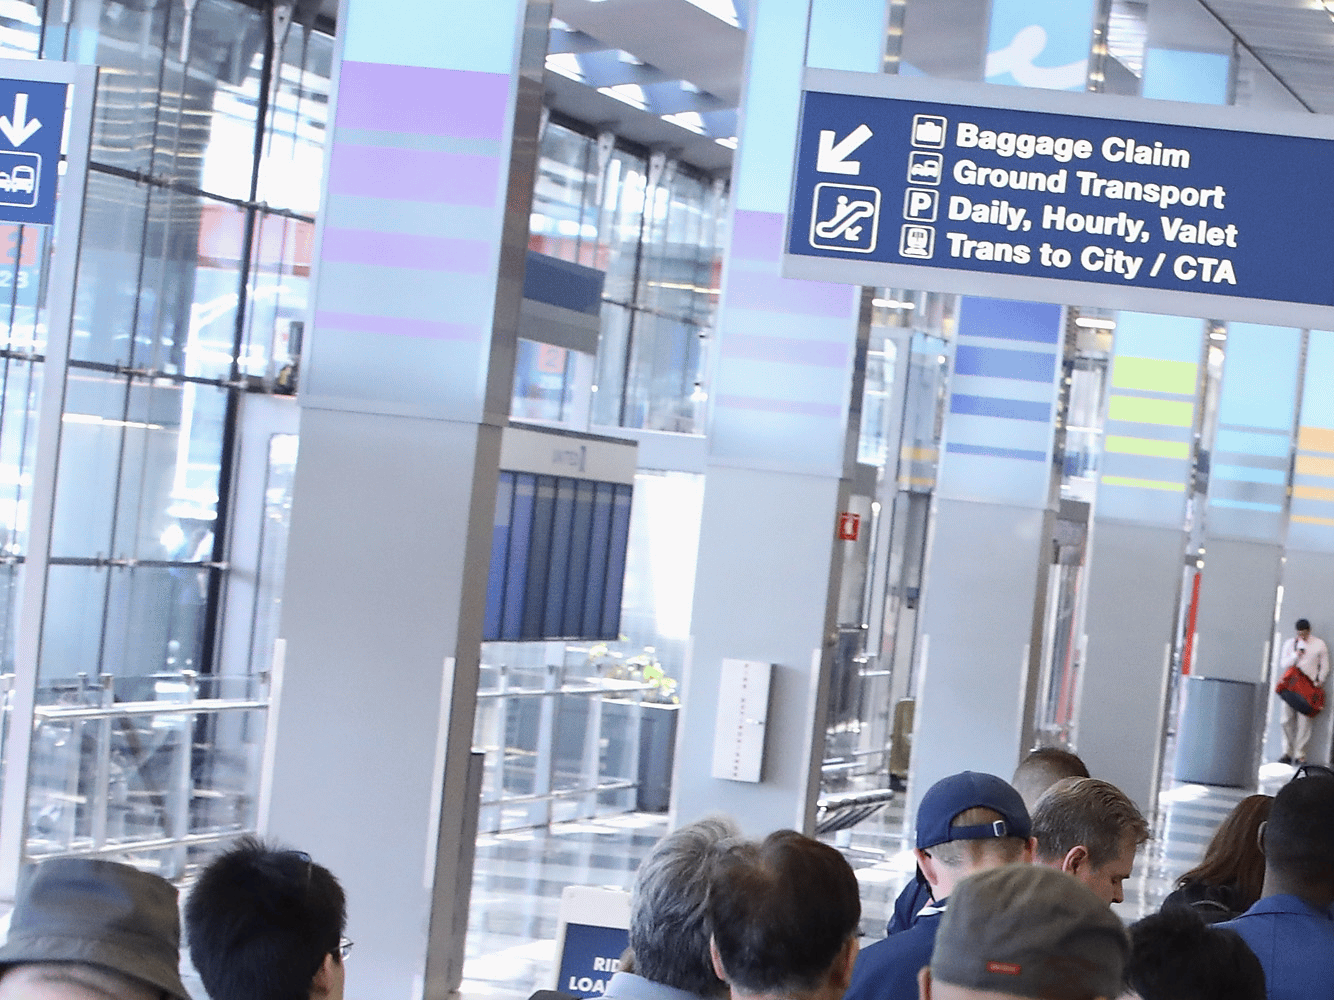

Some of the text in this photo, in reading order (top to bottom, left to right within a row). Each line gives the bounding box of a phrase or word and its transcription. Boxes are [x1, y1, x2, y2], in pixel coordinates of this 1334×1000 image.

[956, 123, 1190, 168] Baggage Claim
[953, 159, 1226, 209] Ground Transport
[948, 196, 1032, 231] Daily,
[1042, 205, 1150, 243] Hourly,
[1160, 216, 1238, 247] Valet
[946, 232, 1237, 284] Trans to City / CTA
[568, 976, 606, 994] LOA
[593, 956, 621, 973] RID
